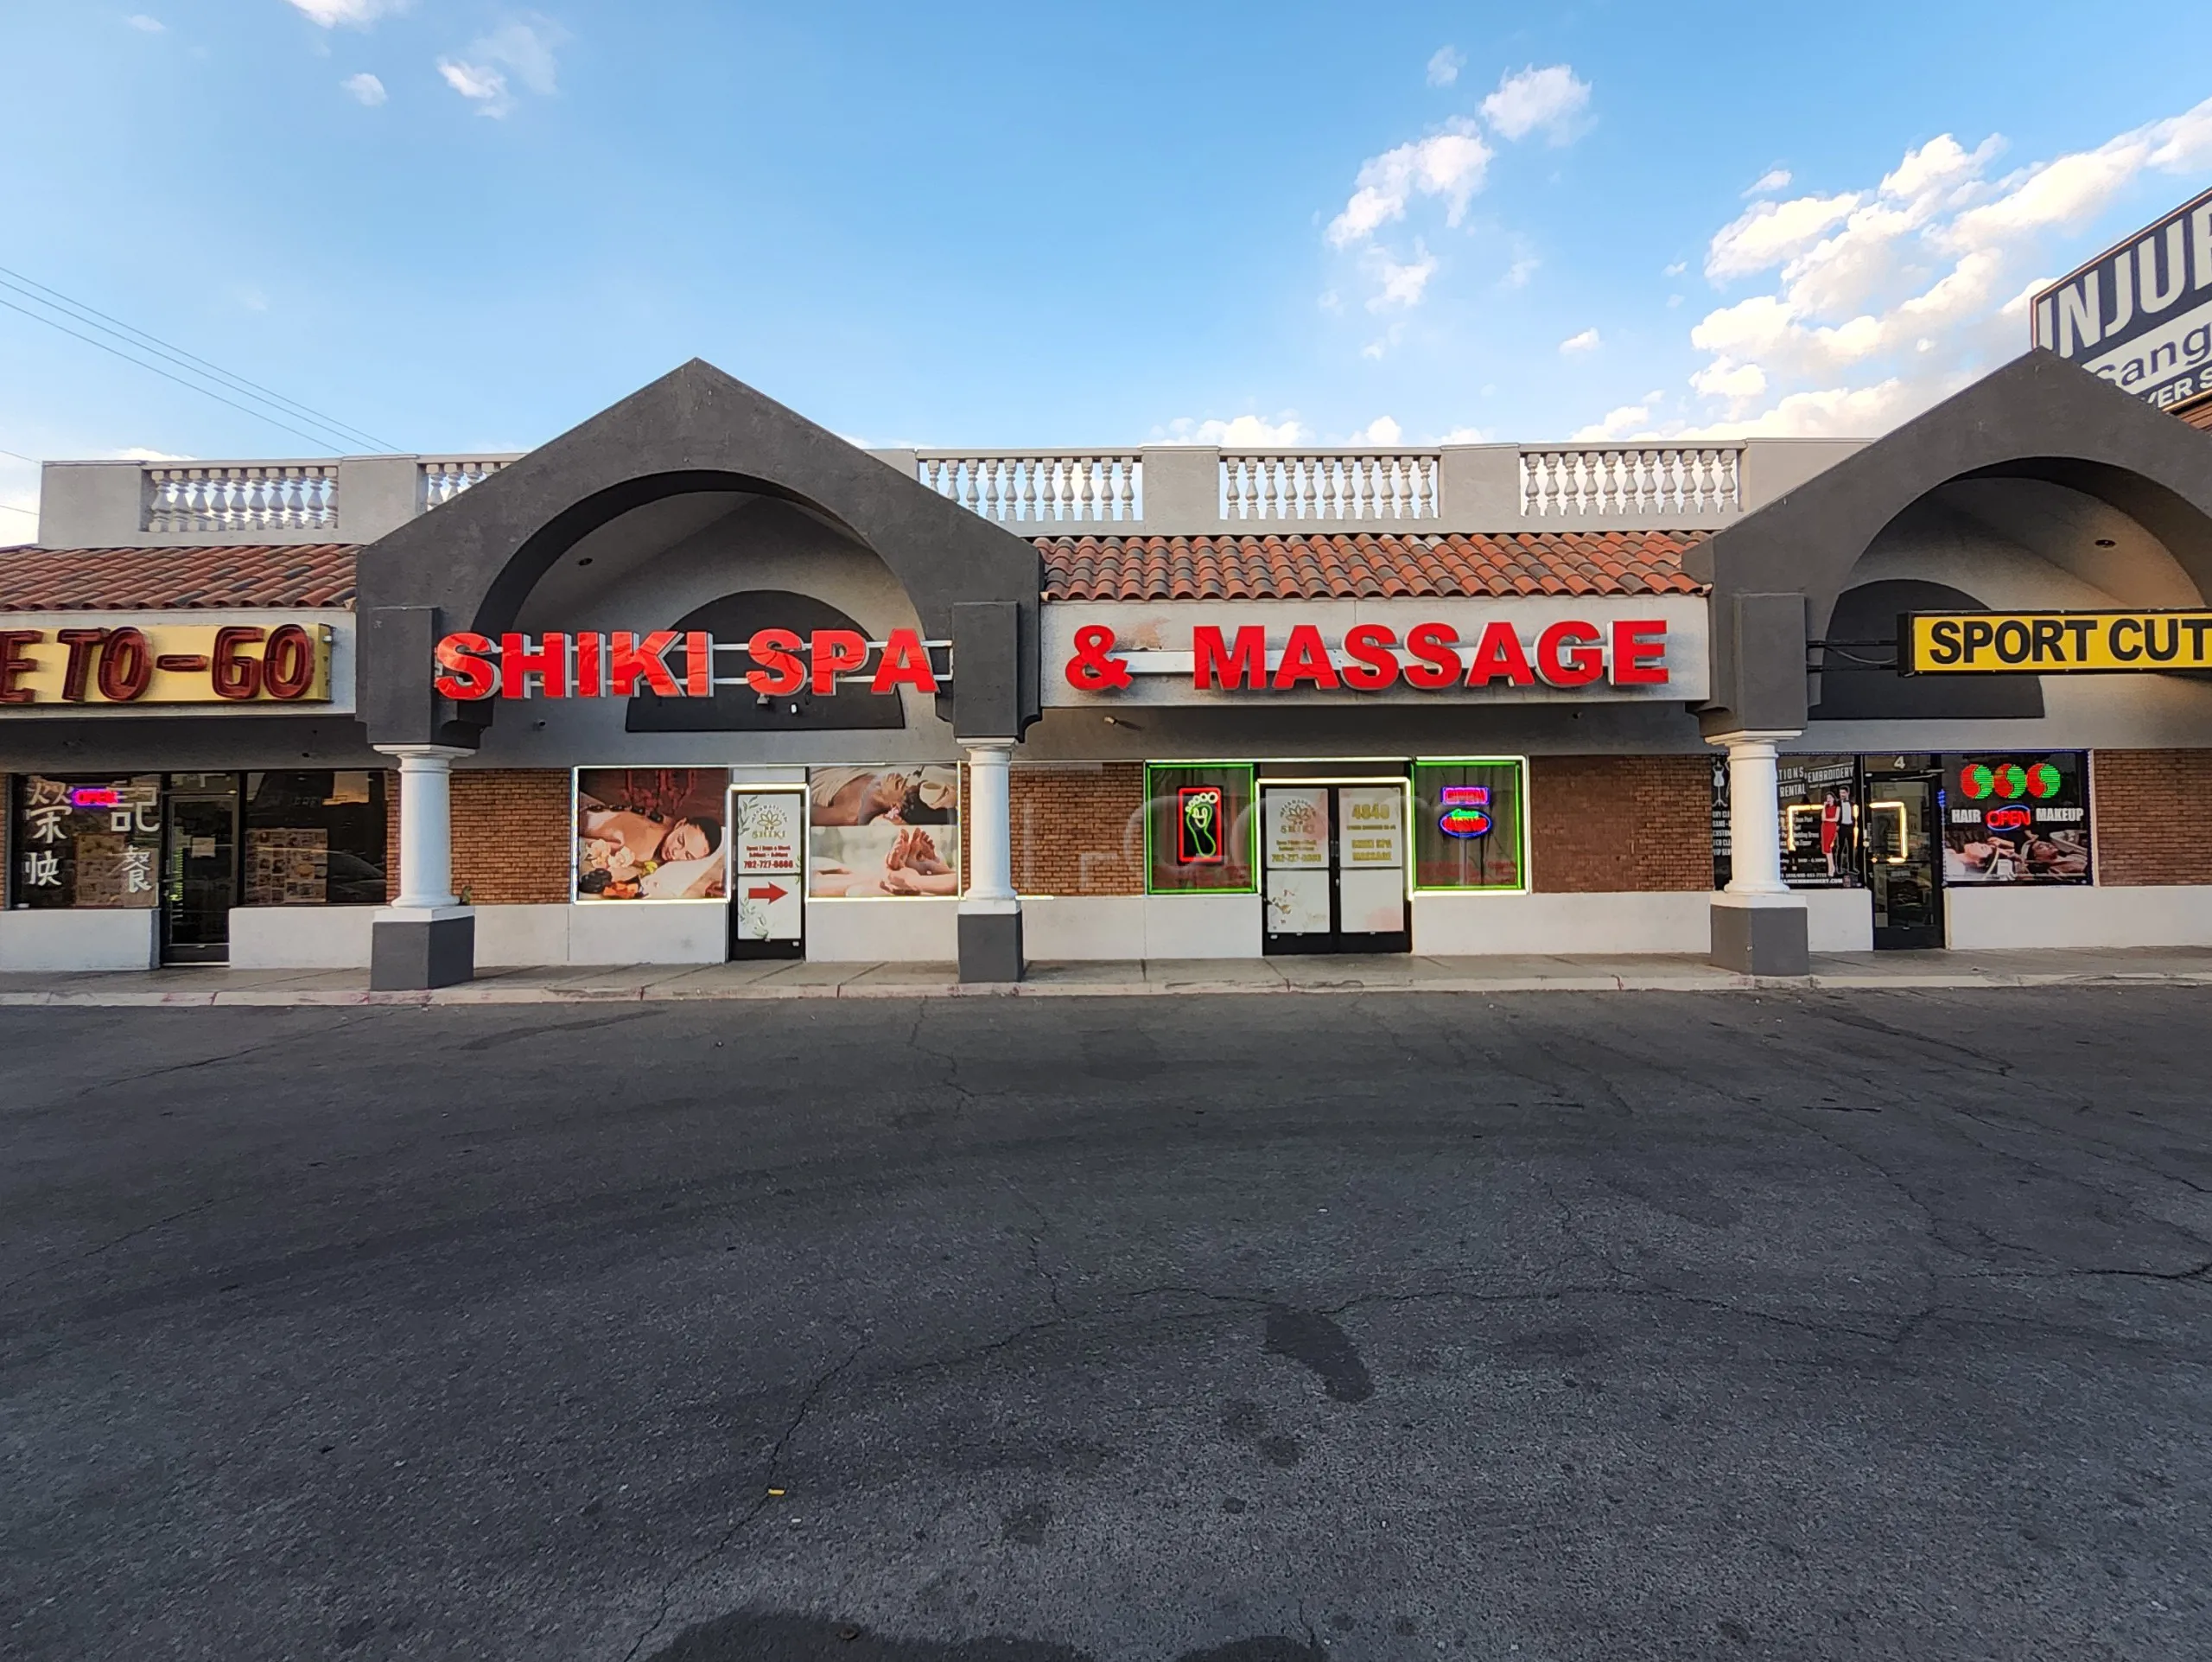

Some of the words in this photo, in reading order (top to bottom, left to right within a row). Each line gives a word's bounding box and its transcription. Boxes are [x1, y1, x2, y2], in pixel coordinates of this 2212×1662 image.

[1929, 620, 2097, 663] SPORT
[2108, 617, 2212, 661] CUT
[1065, 624, 1132, 691] &
[1192, 619, 1670, 691] MASSAGE
[435, 631, 709, 699] SHIKI
[747, 628, 939, 697] SPA
[1893, 755, 1906, 769] 4
[1808, 766, 1854, 783] EMBROIDERY
[1780, 783, 1807, 797] RENTAL
[1951, 809, 1981, 823] HAIR
[2036, 808, 2084, 822] MAKEUP
[1988, 810, 2031, 826] OPEN
